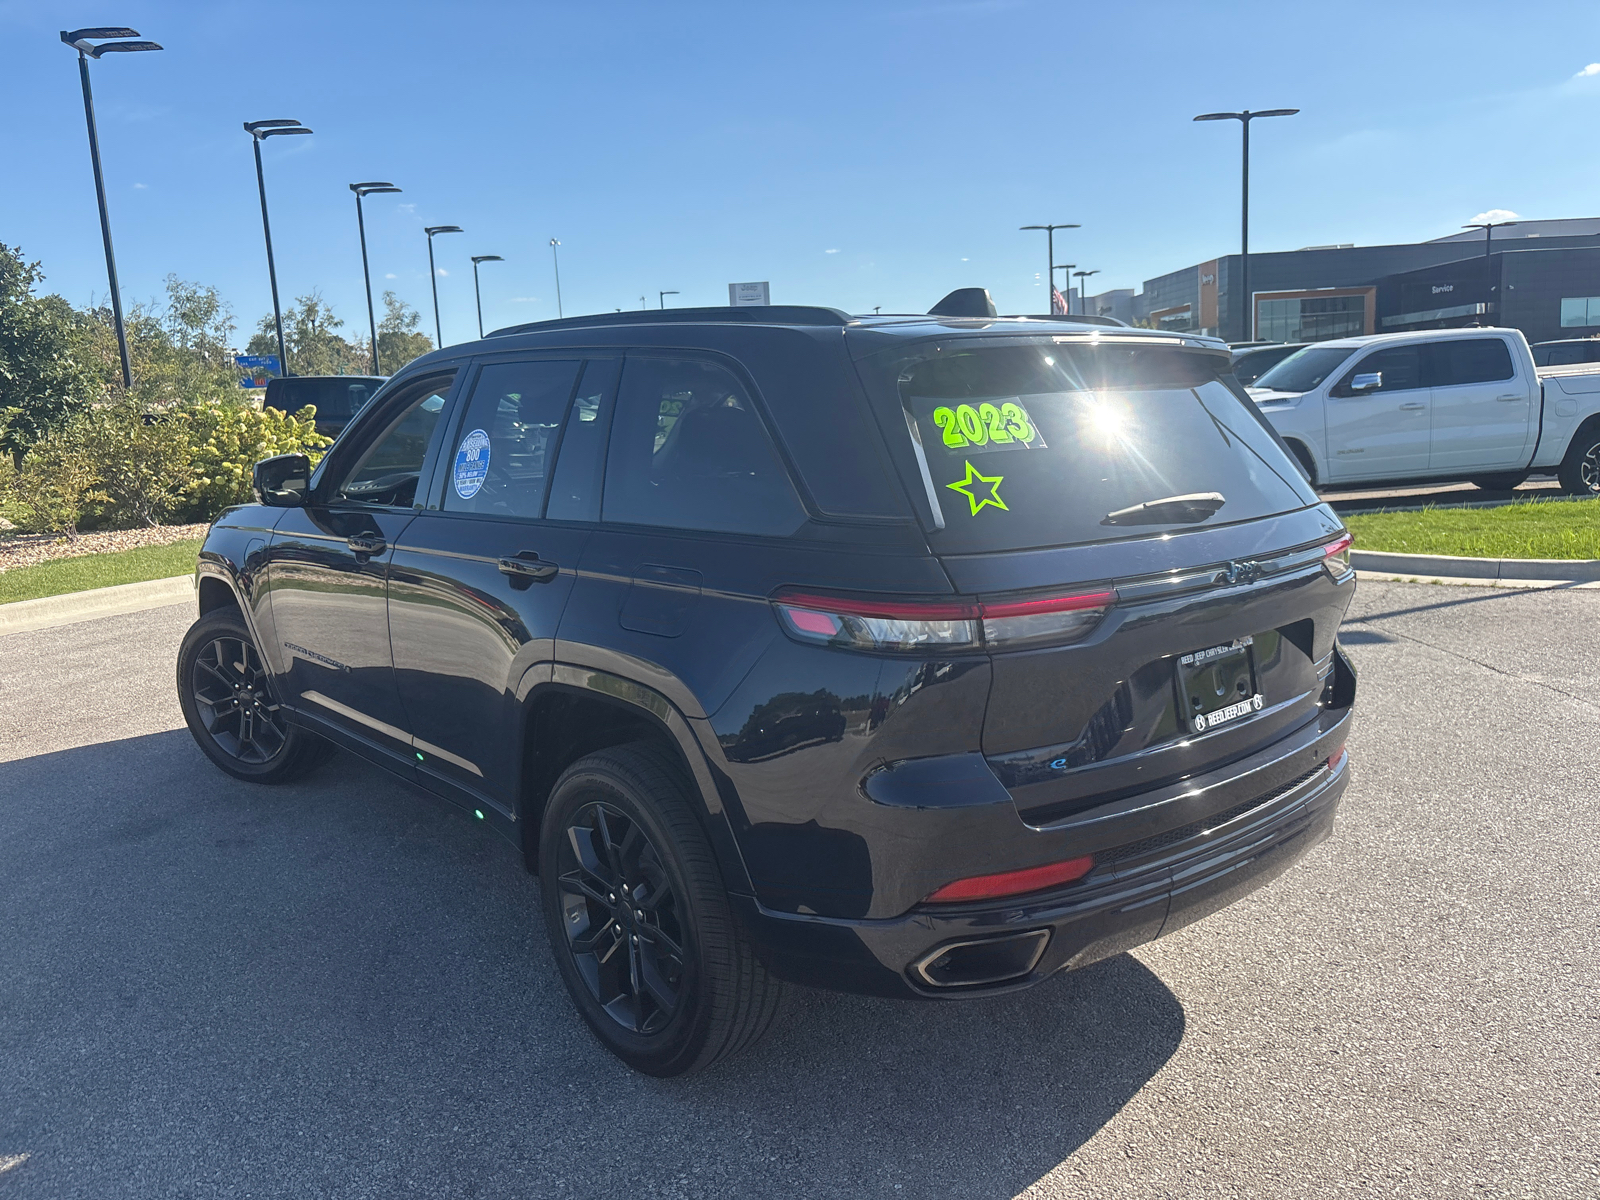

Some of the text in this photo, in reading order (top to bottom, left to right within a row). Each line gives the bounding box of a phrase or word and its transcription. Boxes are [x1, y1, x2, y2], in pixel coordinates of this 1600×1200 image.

[1431, 284, 1454, 294] Service
[933, 402, 1035, 448] 2023
[1181, 653, 1194, 665] REED
[1194, 650, 1206, 661] JEEP
[1205, 645, 1229, 658] CHRYSLER
[1207, 700, 1252, 726] REEDJEEP.COM
